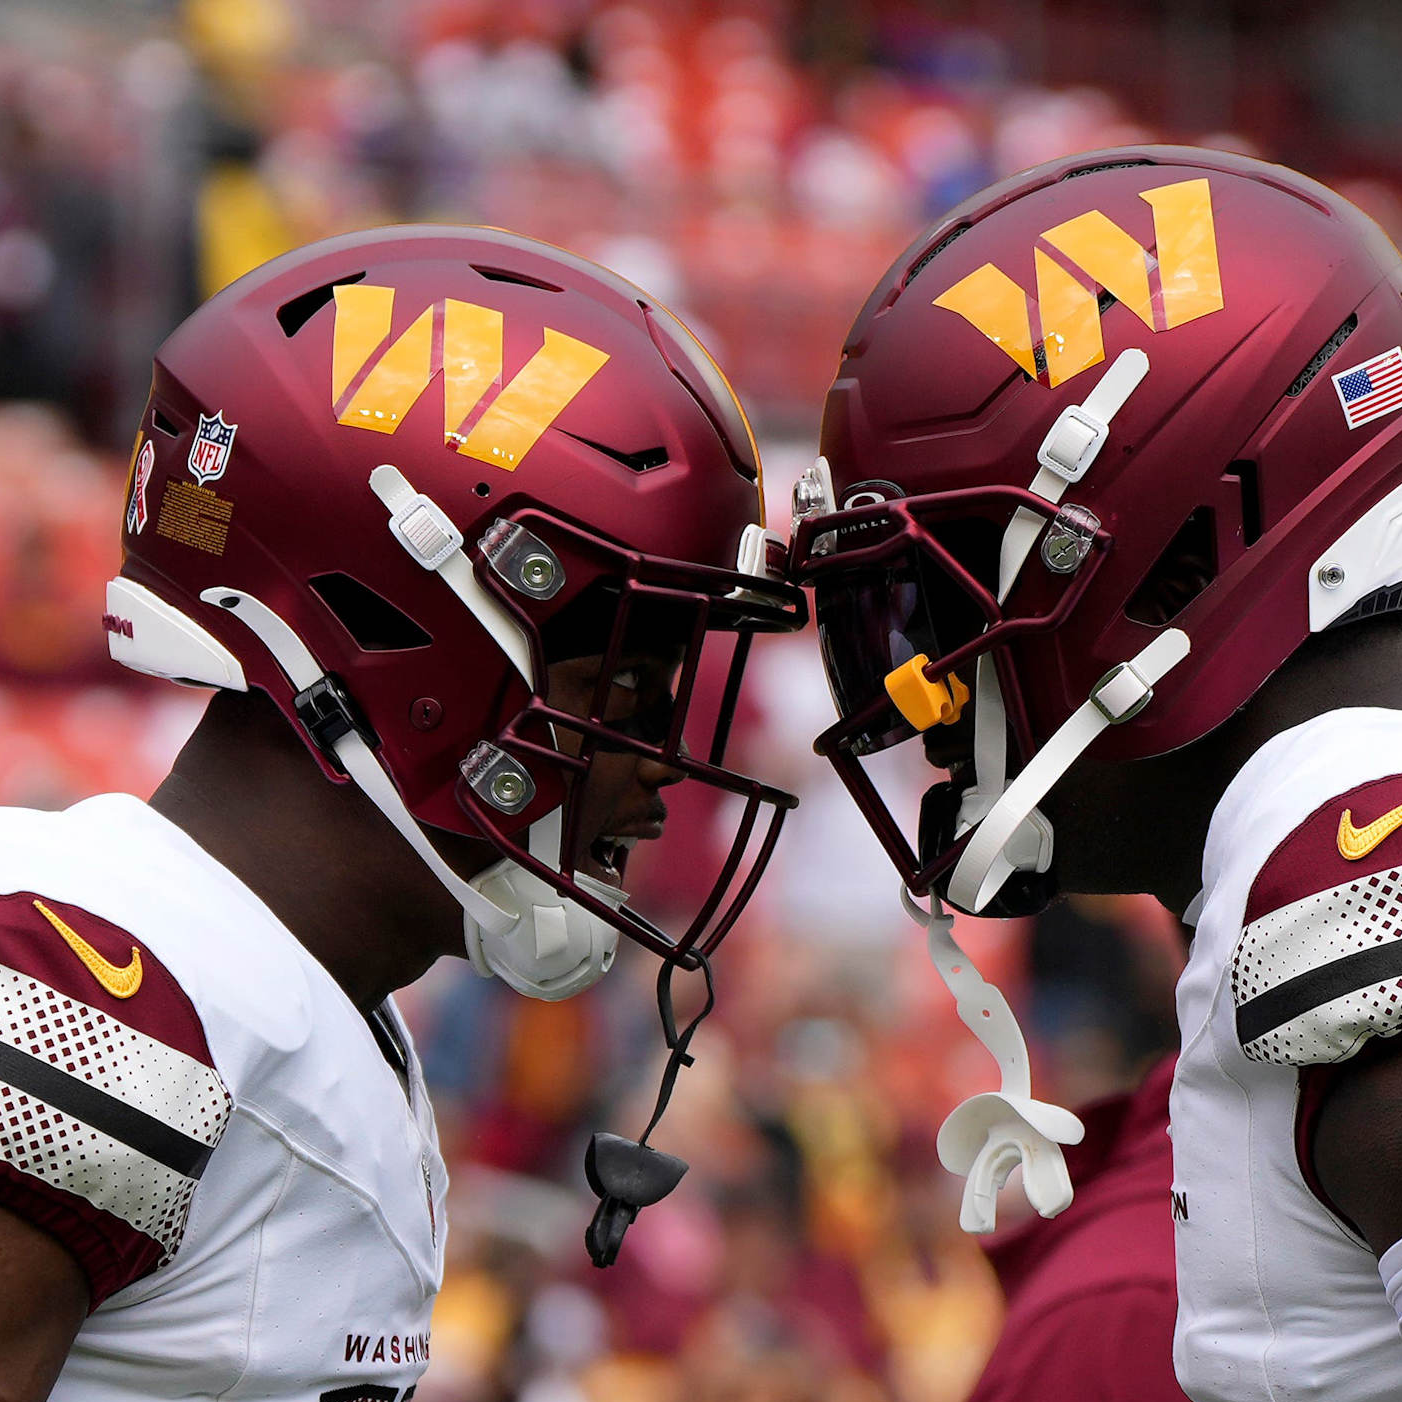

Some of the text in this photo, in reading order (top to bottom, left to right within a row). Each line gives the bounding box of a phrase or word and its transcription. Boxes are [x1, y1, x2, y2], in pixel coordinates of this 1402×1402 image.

[932, 178, 1224, 389] W
[332, 284, 610, 471] W
[181, 480, 217, 498] WARNING
[193, 441, 222, 472] NFL
